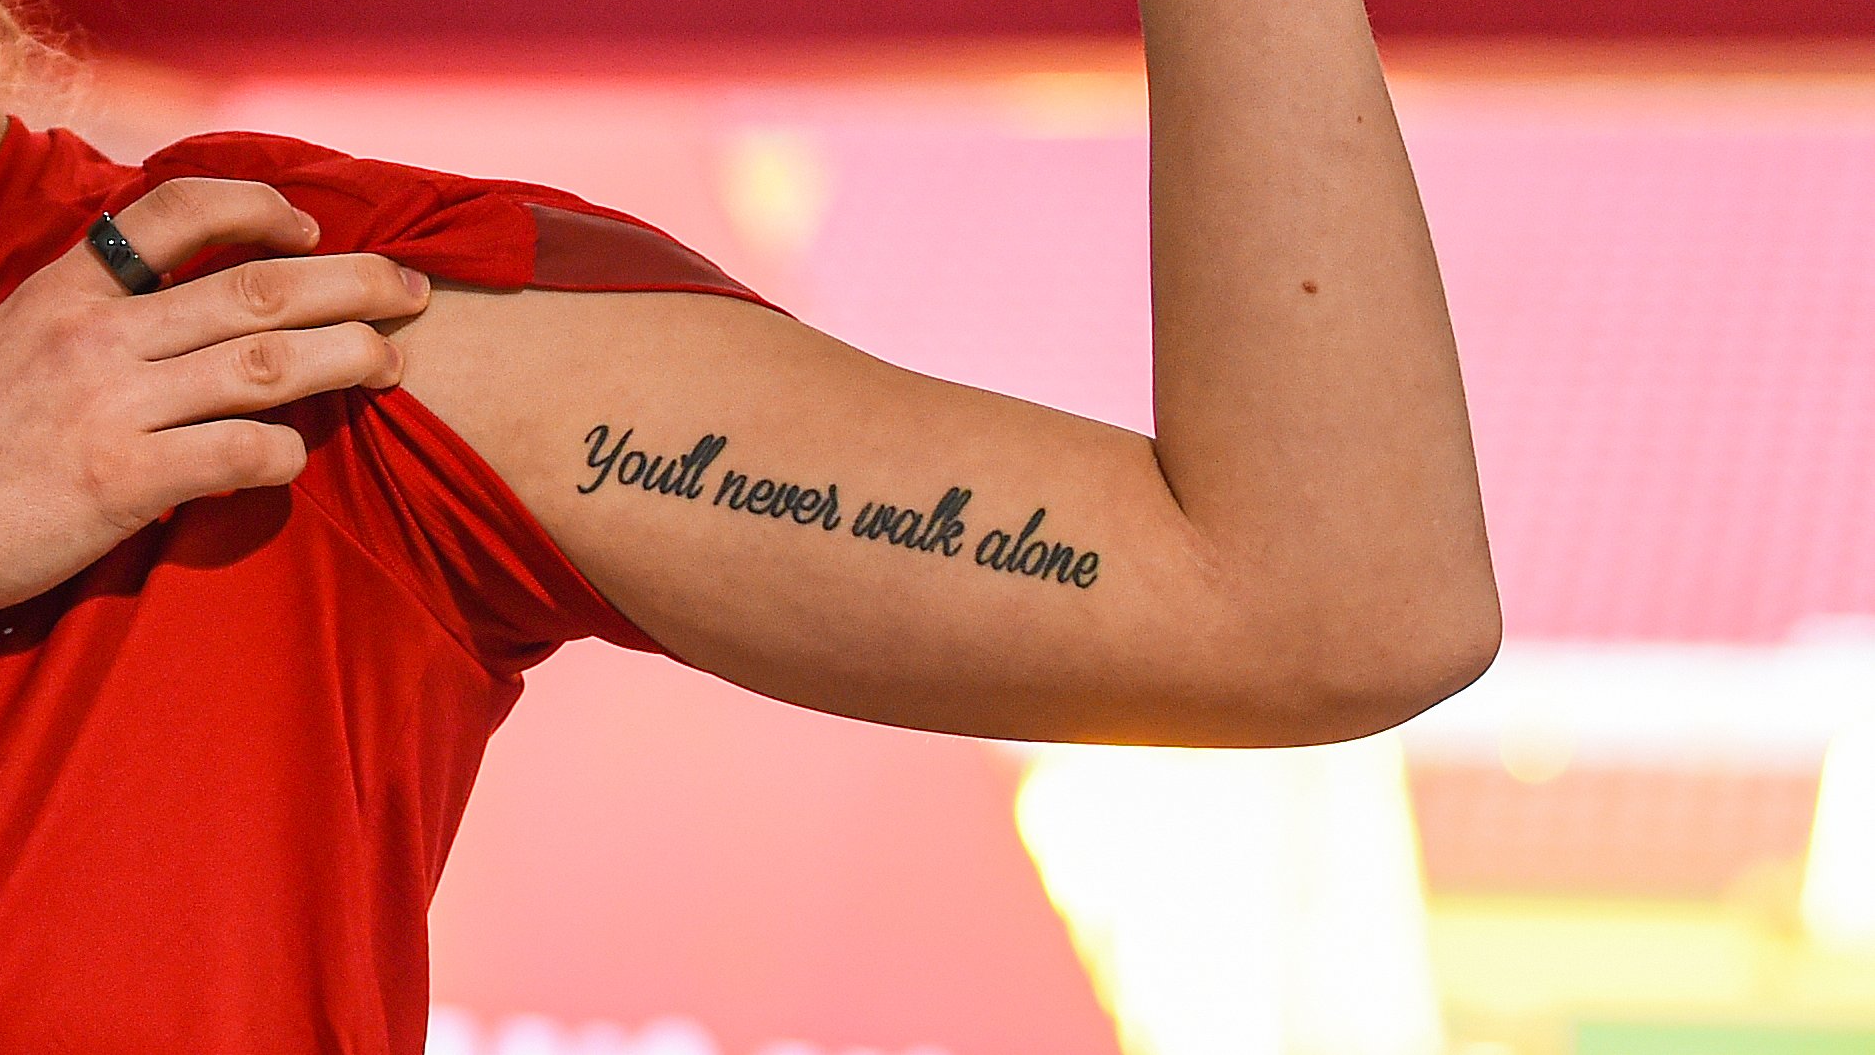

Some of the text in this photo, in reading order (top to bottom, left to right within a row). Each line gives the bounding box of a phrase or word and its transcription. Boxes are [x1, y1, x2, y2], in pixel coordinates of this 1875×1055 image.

[713, 469, 841, 531] never
[852, 486, 972, 557] walk
[975, 507, 1100, 588] alone
